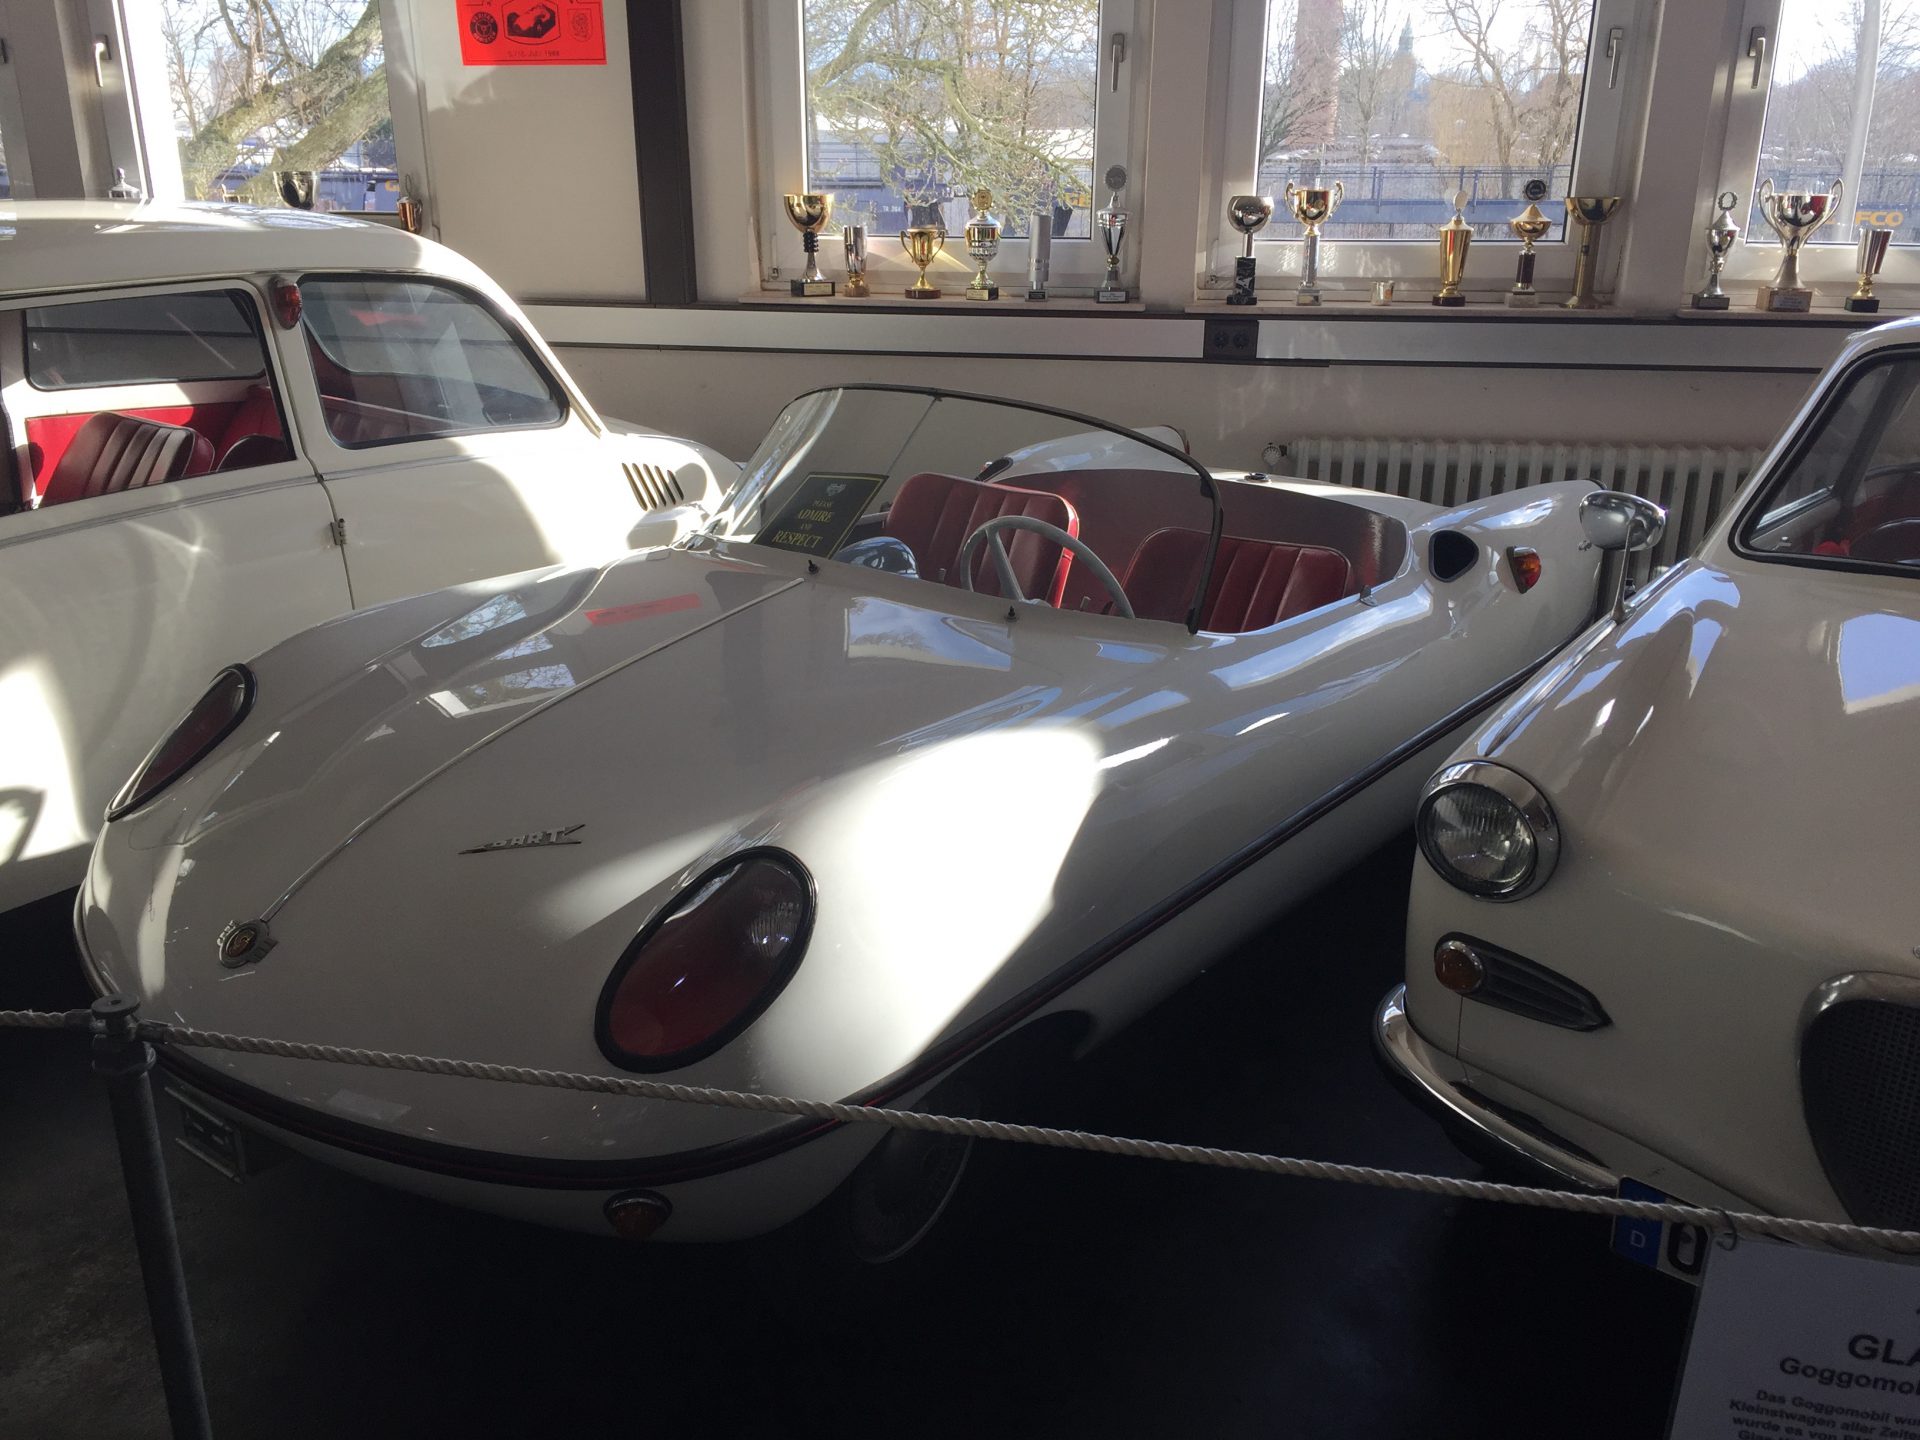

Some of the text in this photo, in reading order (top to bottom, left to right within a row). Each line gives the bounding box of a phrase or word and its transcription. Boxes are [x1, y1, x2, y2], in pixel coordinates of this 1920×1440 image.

[799, 509, 833, 521] ADMIRE
[771, 530, 824, 548] RESPECT
[1630, 1230, 1647, 1249] D
[1779, 1356, 1920, 1396] Goggomo
[1756, 1389, 1786, 1404] Das
[1791, 1396, 1890, 1423] Goggomobil
[1732, 1415, 1781, 1432] wurde
[1785, 1425, 1804, 1437] es
[1879, 1425, 1920, 1440] Zeite
